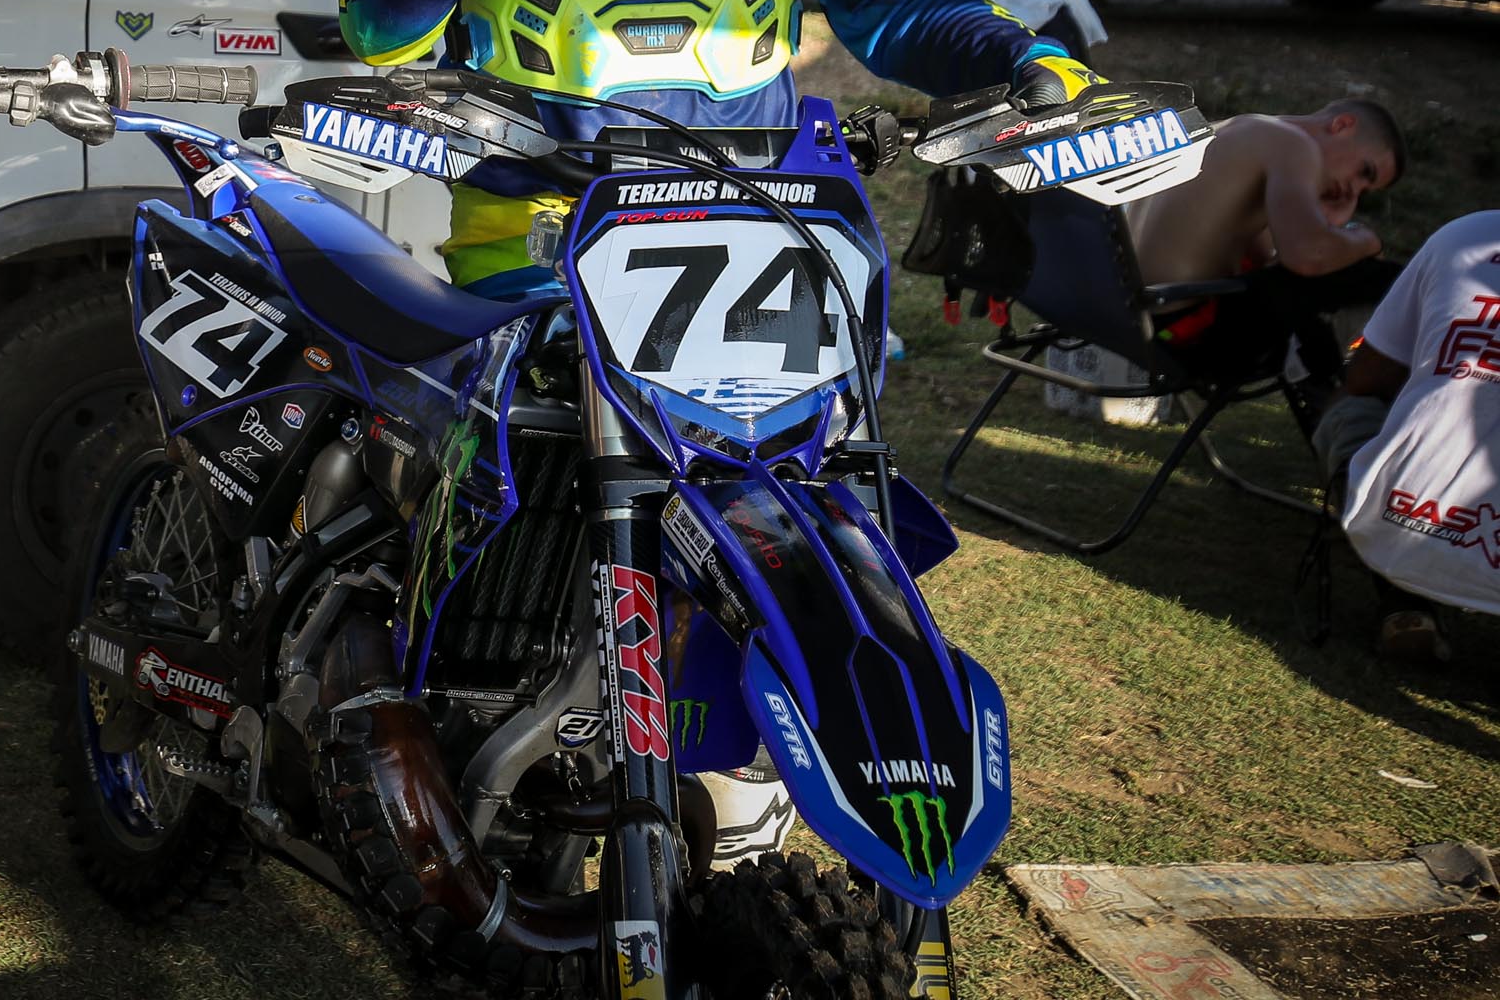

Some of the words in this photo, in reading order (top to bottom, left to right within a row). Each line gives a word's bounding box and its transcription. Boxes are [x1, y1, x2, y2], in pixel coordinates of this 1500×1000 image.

[218, 32, 276, 50] VHM
[627, 23, 684, 37] GUARDIAN
[413, 105, 469, 129] DIGENIS
[1025, 112, 1080, 134] DIGENIS
[303, 103, 447, 173] YAMAHA
[678, 146, 738, 161] YAMA
[1027, 109, 1190, 182] YAMAHA
[617, 180, 717, 205] TERZAKIS
[720, 181, 740, 200] M
[615, 209, 708, 224] TOP-GUN
[209, 273, 251, 302] TERZAKIS
[253, 300, 287, 324] JUNIOR
[624, 244, 839, 374] 74
[141, 270, 288, 398] 74
[284, 408, 303, 427] 100%
[250, 419, 283, 452] thor
[88, 633, 125, 676] YAMAHA
[601, 572, 611, 633] Racing
[608, 648, 622, 755] Suspension
[612, 564, 669, 761] KYB
[560, 717, 602, 736] 21
[765, 691, 811, 769] GYTR
[985, 707, 1002, 790] GYTR
[858, 761, 956, 789] YAMAHA
